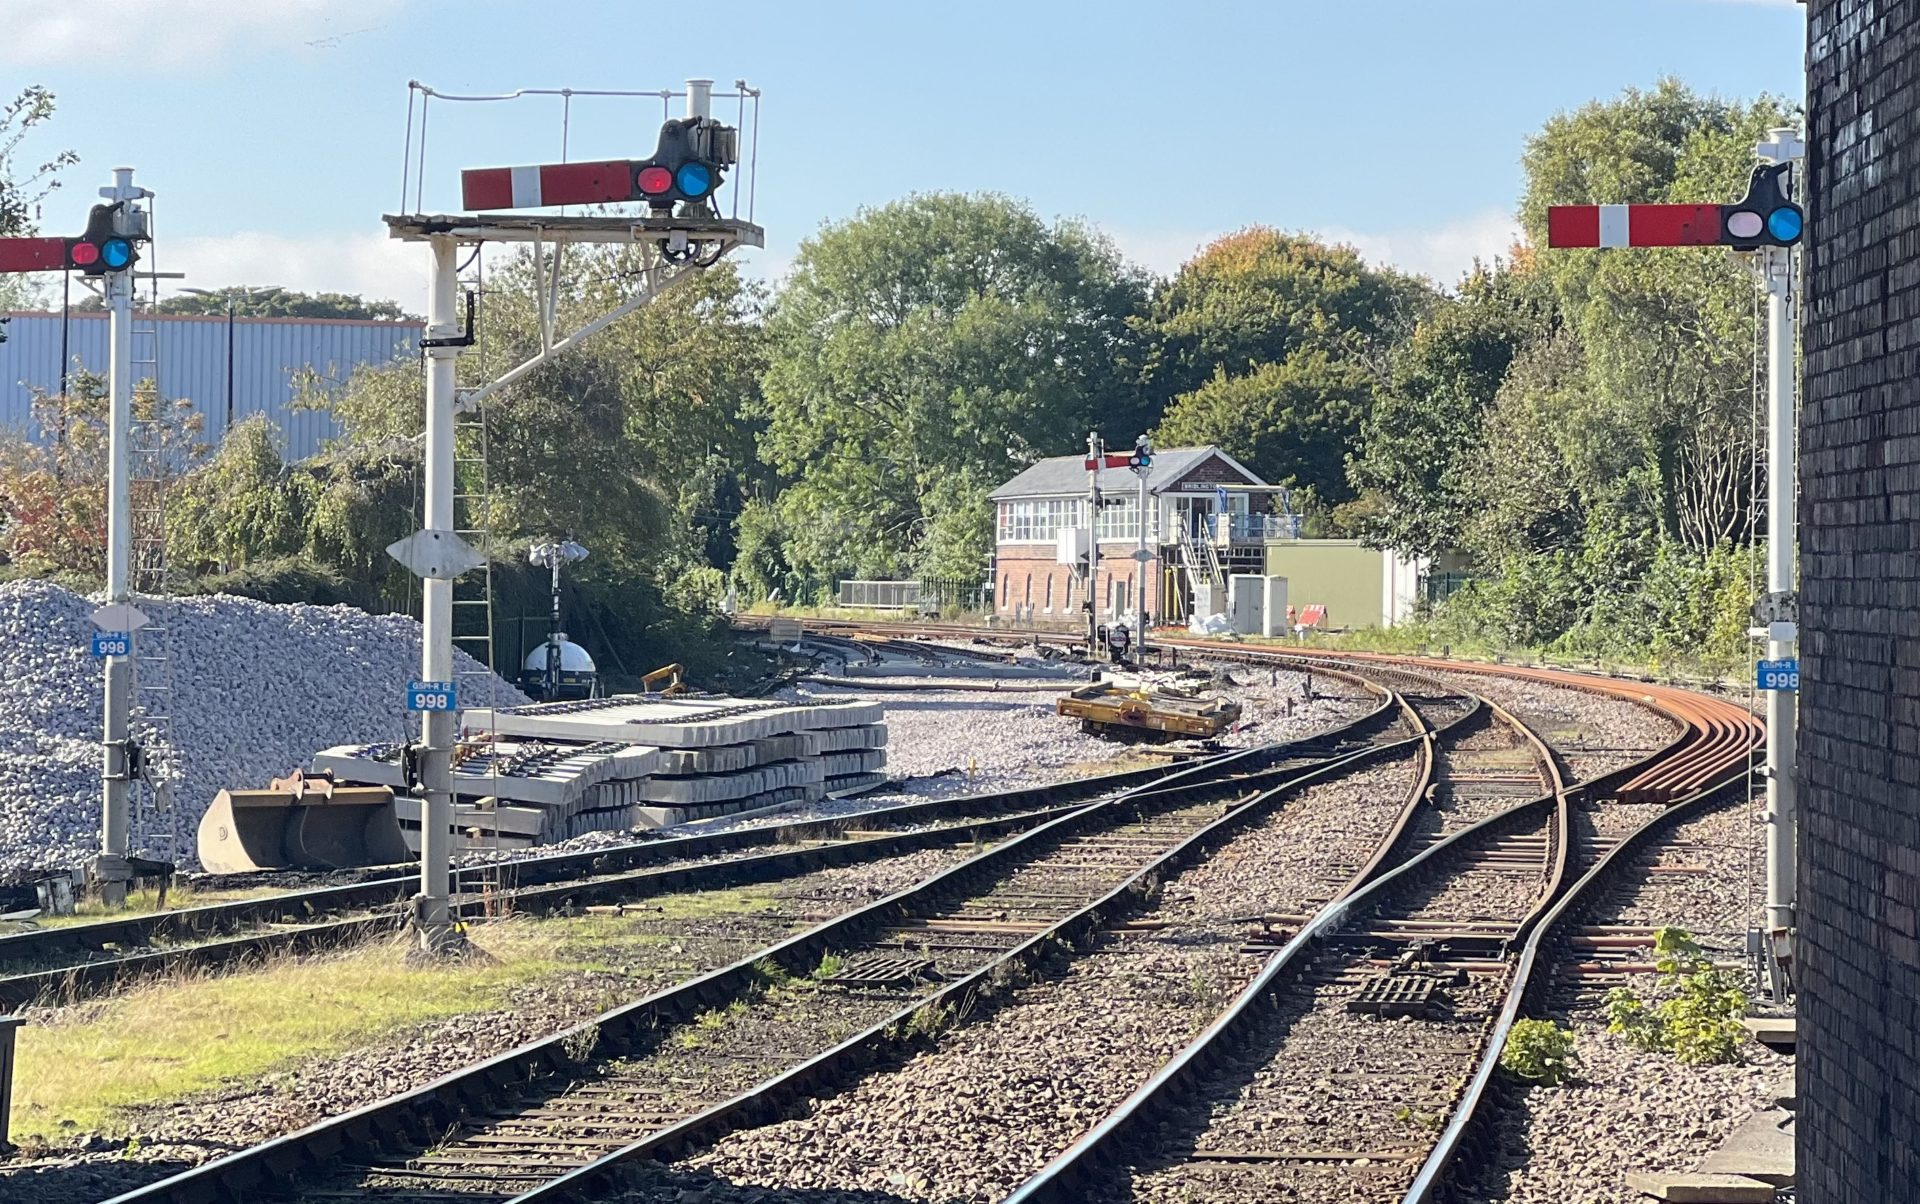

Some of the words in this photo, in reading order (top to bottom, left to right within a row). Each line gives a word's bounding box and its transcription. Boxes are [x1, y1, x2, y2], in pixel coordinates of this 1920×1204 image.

[98, 641, 125, 654] 998
[1762, 661, 1792, 669] GSM-R
[412, 681, 440, 690] GSM-R
[1765, 672, 1799, 688] 998
[415, 693, 448, 709] 998
